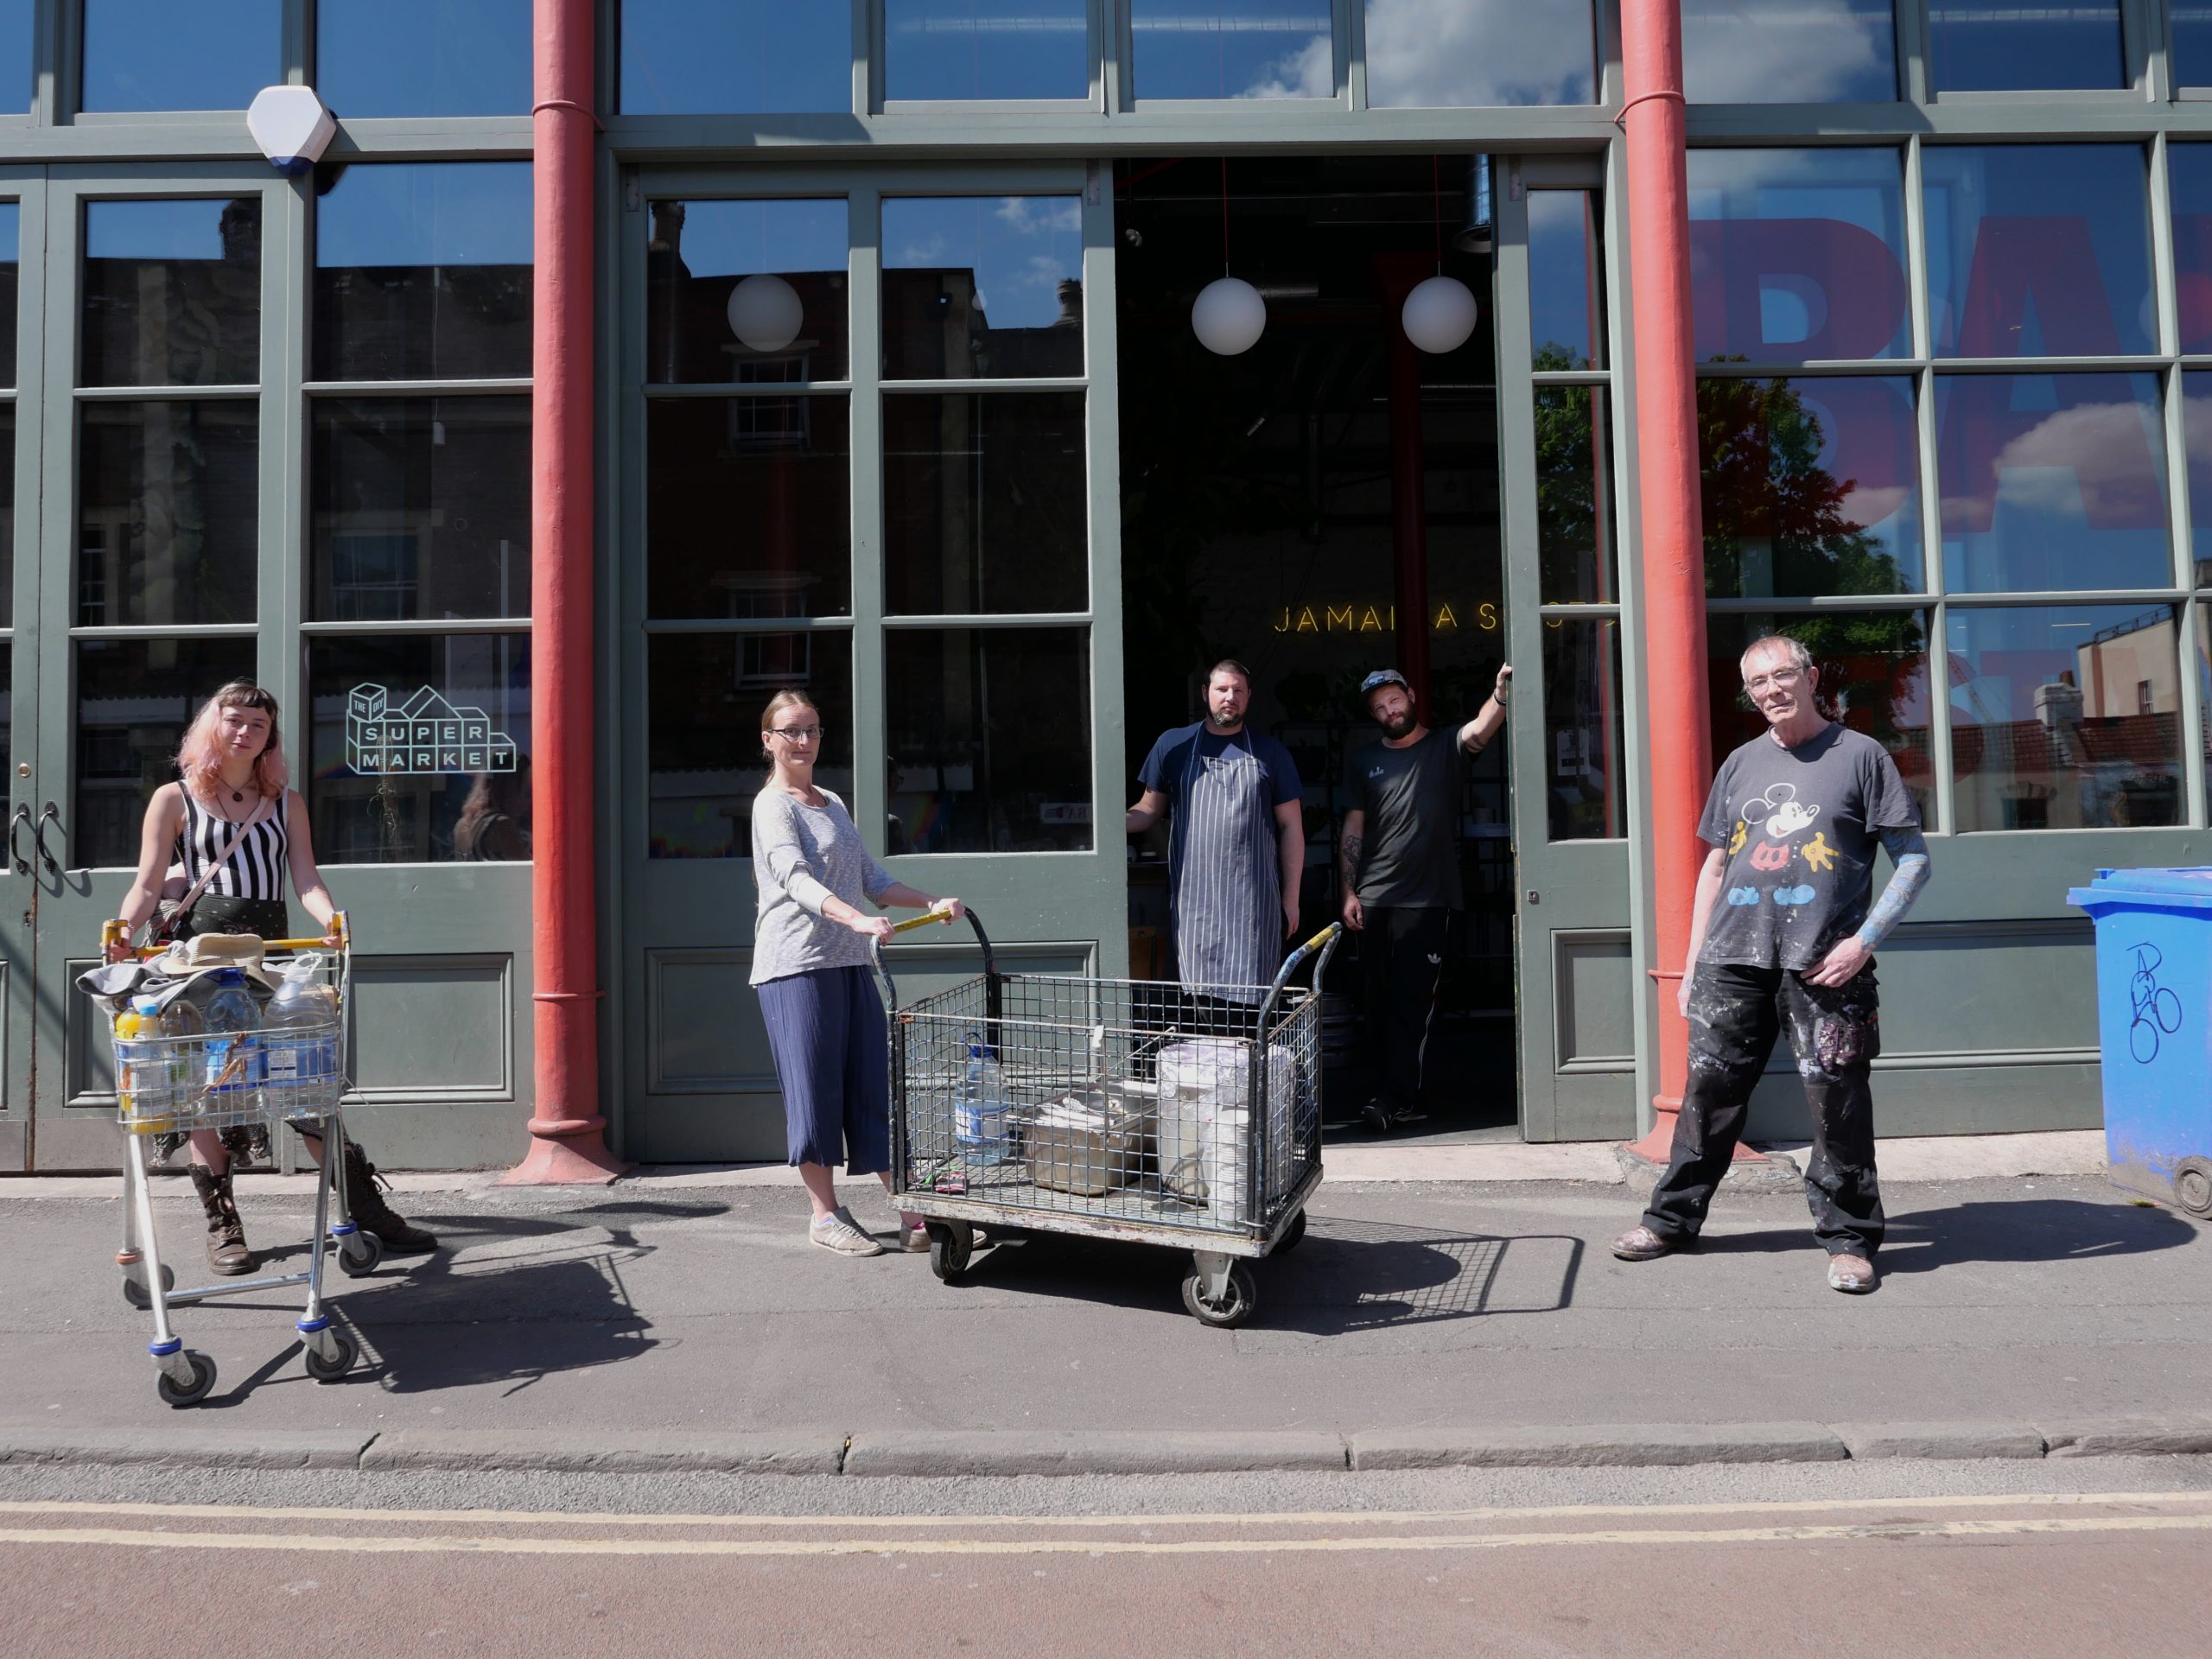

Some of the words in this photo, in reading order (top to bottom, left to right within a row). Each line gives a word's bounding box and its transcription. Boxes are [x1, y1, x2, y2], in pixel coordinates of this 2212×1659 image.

[1688, 213, 2212, 537] BA
[1274, 603, 1458, 632] JAMAIA
[353, 699, 366, 713] THE
[373, 697, 385, 713] DIY
[365, 727, 482, 741] SUPER
[363, 753, 507, 766] MARKET
